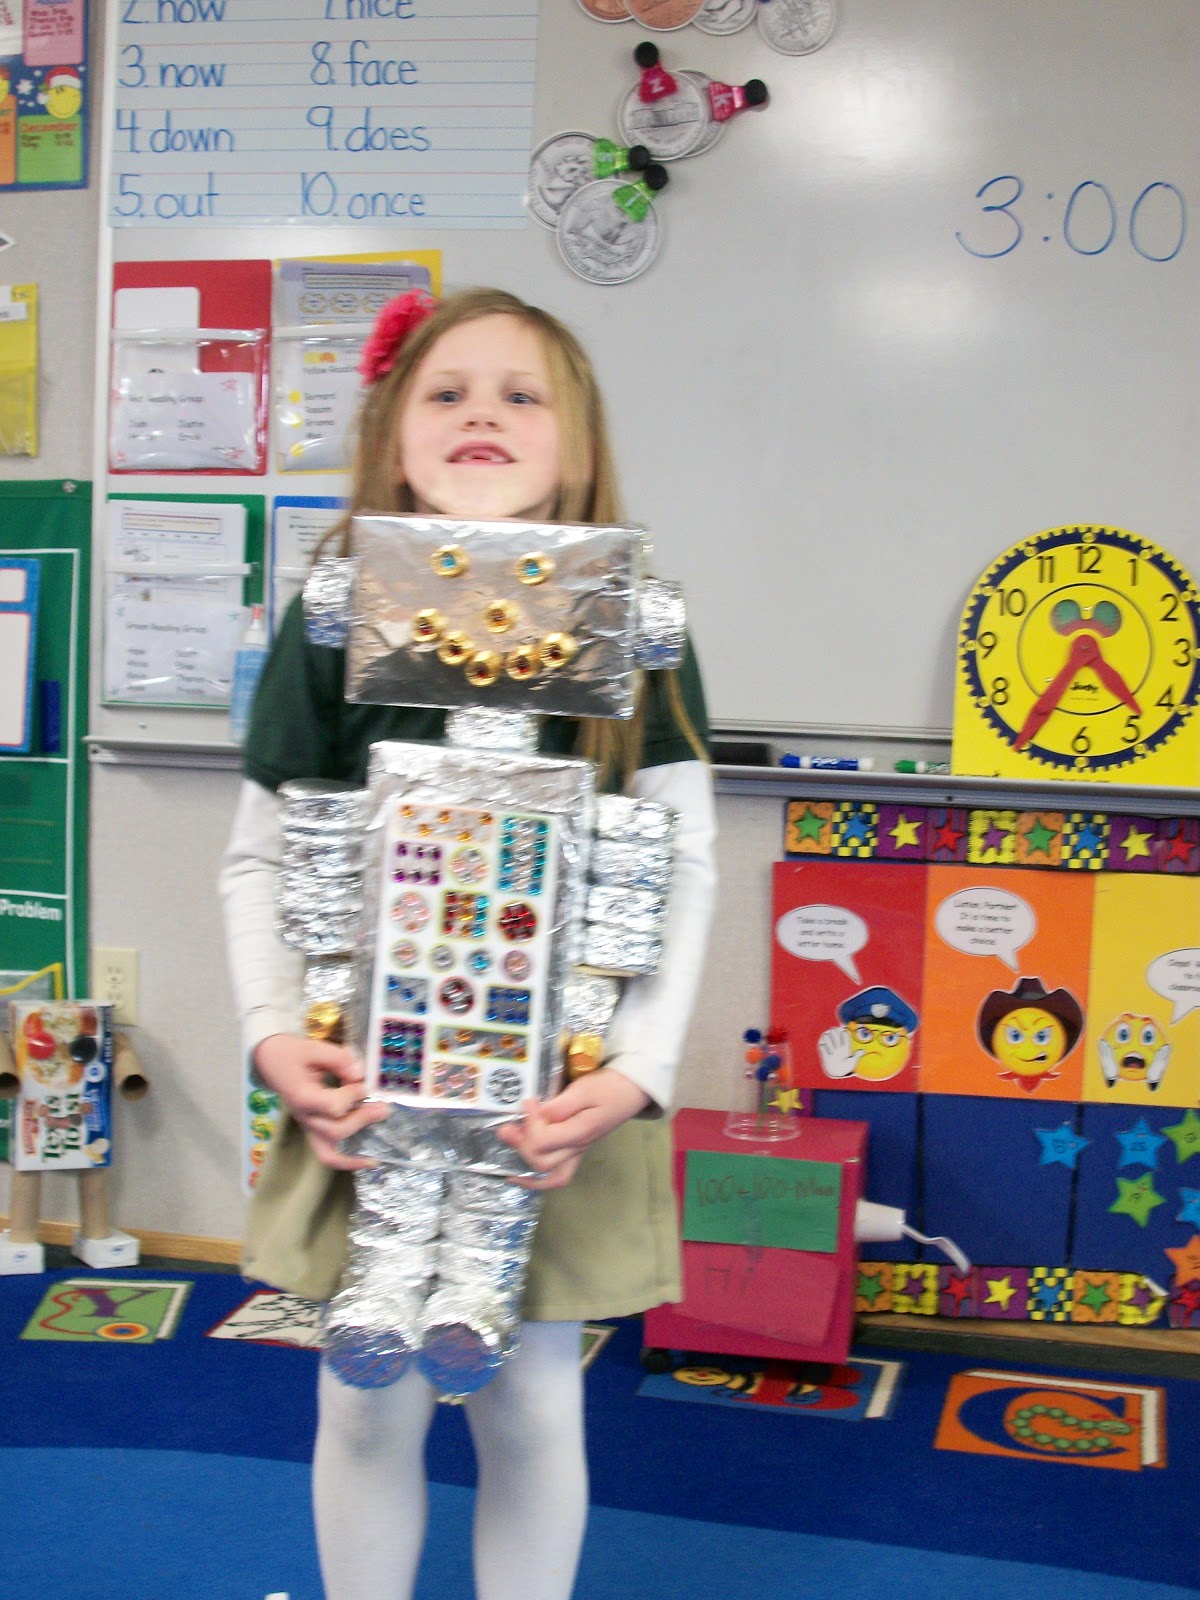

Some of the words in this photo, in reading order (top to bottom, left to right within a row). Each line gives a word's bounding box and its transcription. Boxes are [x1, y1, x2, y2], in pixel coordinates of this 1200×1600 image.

[955, 175, 1188, 263] 3:00
[1036, 555, 1056, 583] 11
[1075, 545, 1103, 574] 12
[1128, 558, 1139, 587] 1
[997, 588, 1027, 617] 10
[1160, 593, 1179, 622] 2
[977, 631, 998, 659] 9
[1172, 638, 1191, 667] 3
[990, 677, 1009, 706] 8
[1155, 684, 1175, 712] 4
[1071, 726, 1091, 754] 6
[1121, 715, 1141, 743] 5
